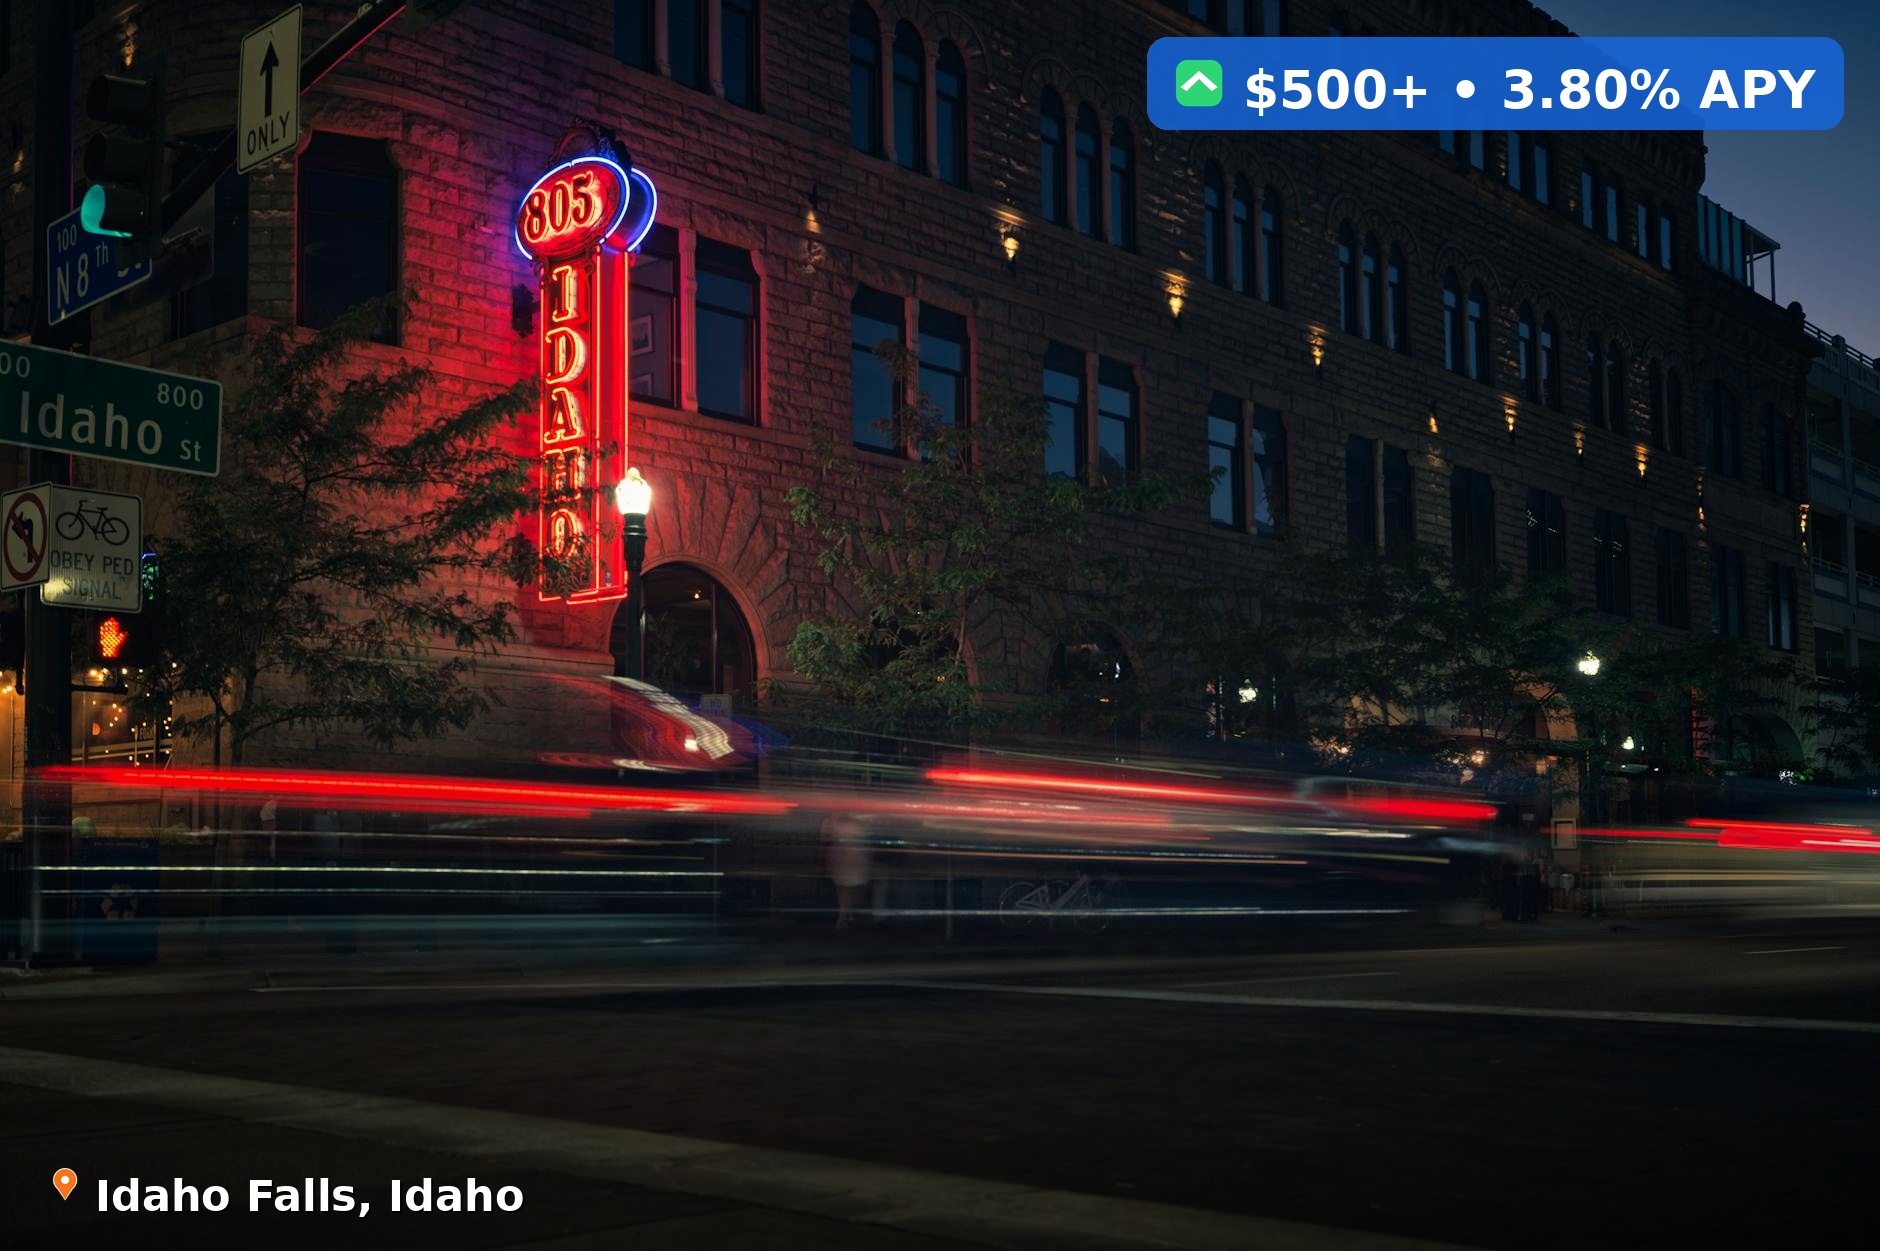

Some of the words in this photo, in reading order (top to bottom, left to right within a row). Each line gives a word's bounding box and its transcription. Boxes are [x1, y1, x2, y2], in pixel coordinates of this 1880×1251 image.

[247, 112, 290, 154] ONLY
[524, 171, 596, 243] 805
[56, 223, 77, 253] 100
[56, 265, 70, 308] N
[156, 382, 204, 411] 800
[544, 265, 586, 558] IDAHO
[19, 389, 163, 455] Idaho
[179, 438, 202, 463] St
[50, 550, 95, 572] OBEY
[103, 555, 134, 576] PED
[62, 576, 122, 601] SIGNAL
